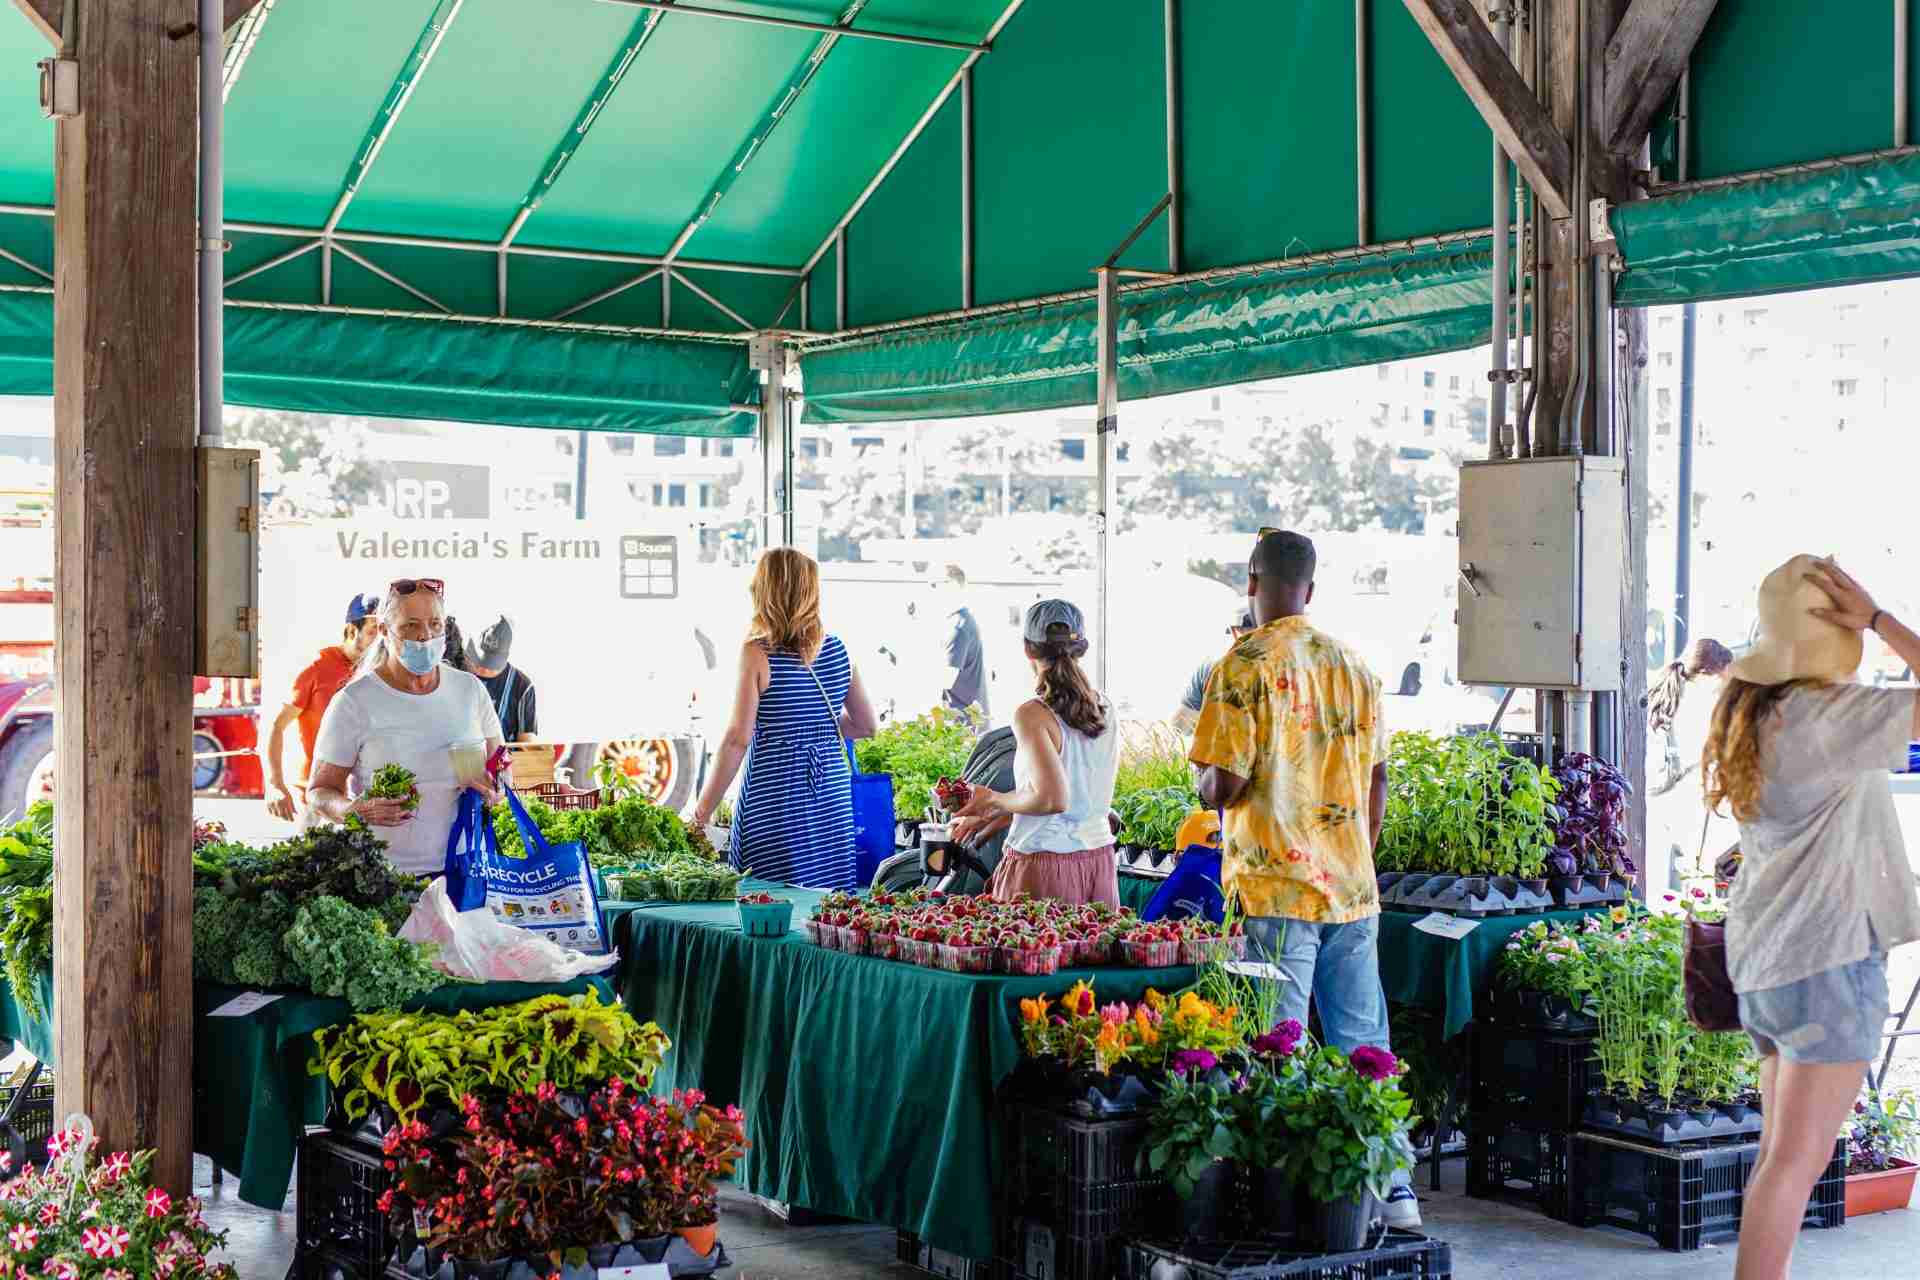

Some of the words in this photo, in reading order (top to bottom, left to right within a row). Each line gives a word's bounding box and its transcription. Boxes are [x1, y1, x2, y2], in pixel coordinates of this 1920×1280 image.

[336, 531, 509, 559] Valencia's
[521, 531, 601, 559] Farm
[488, 862, 558, 884] RECYCLE
